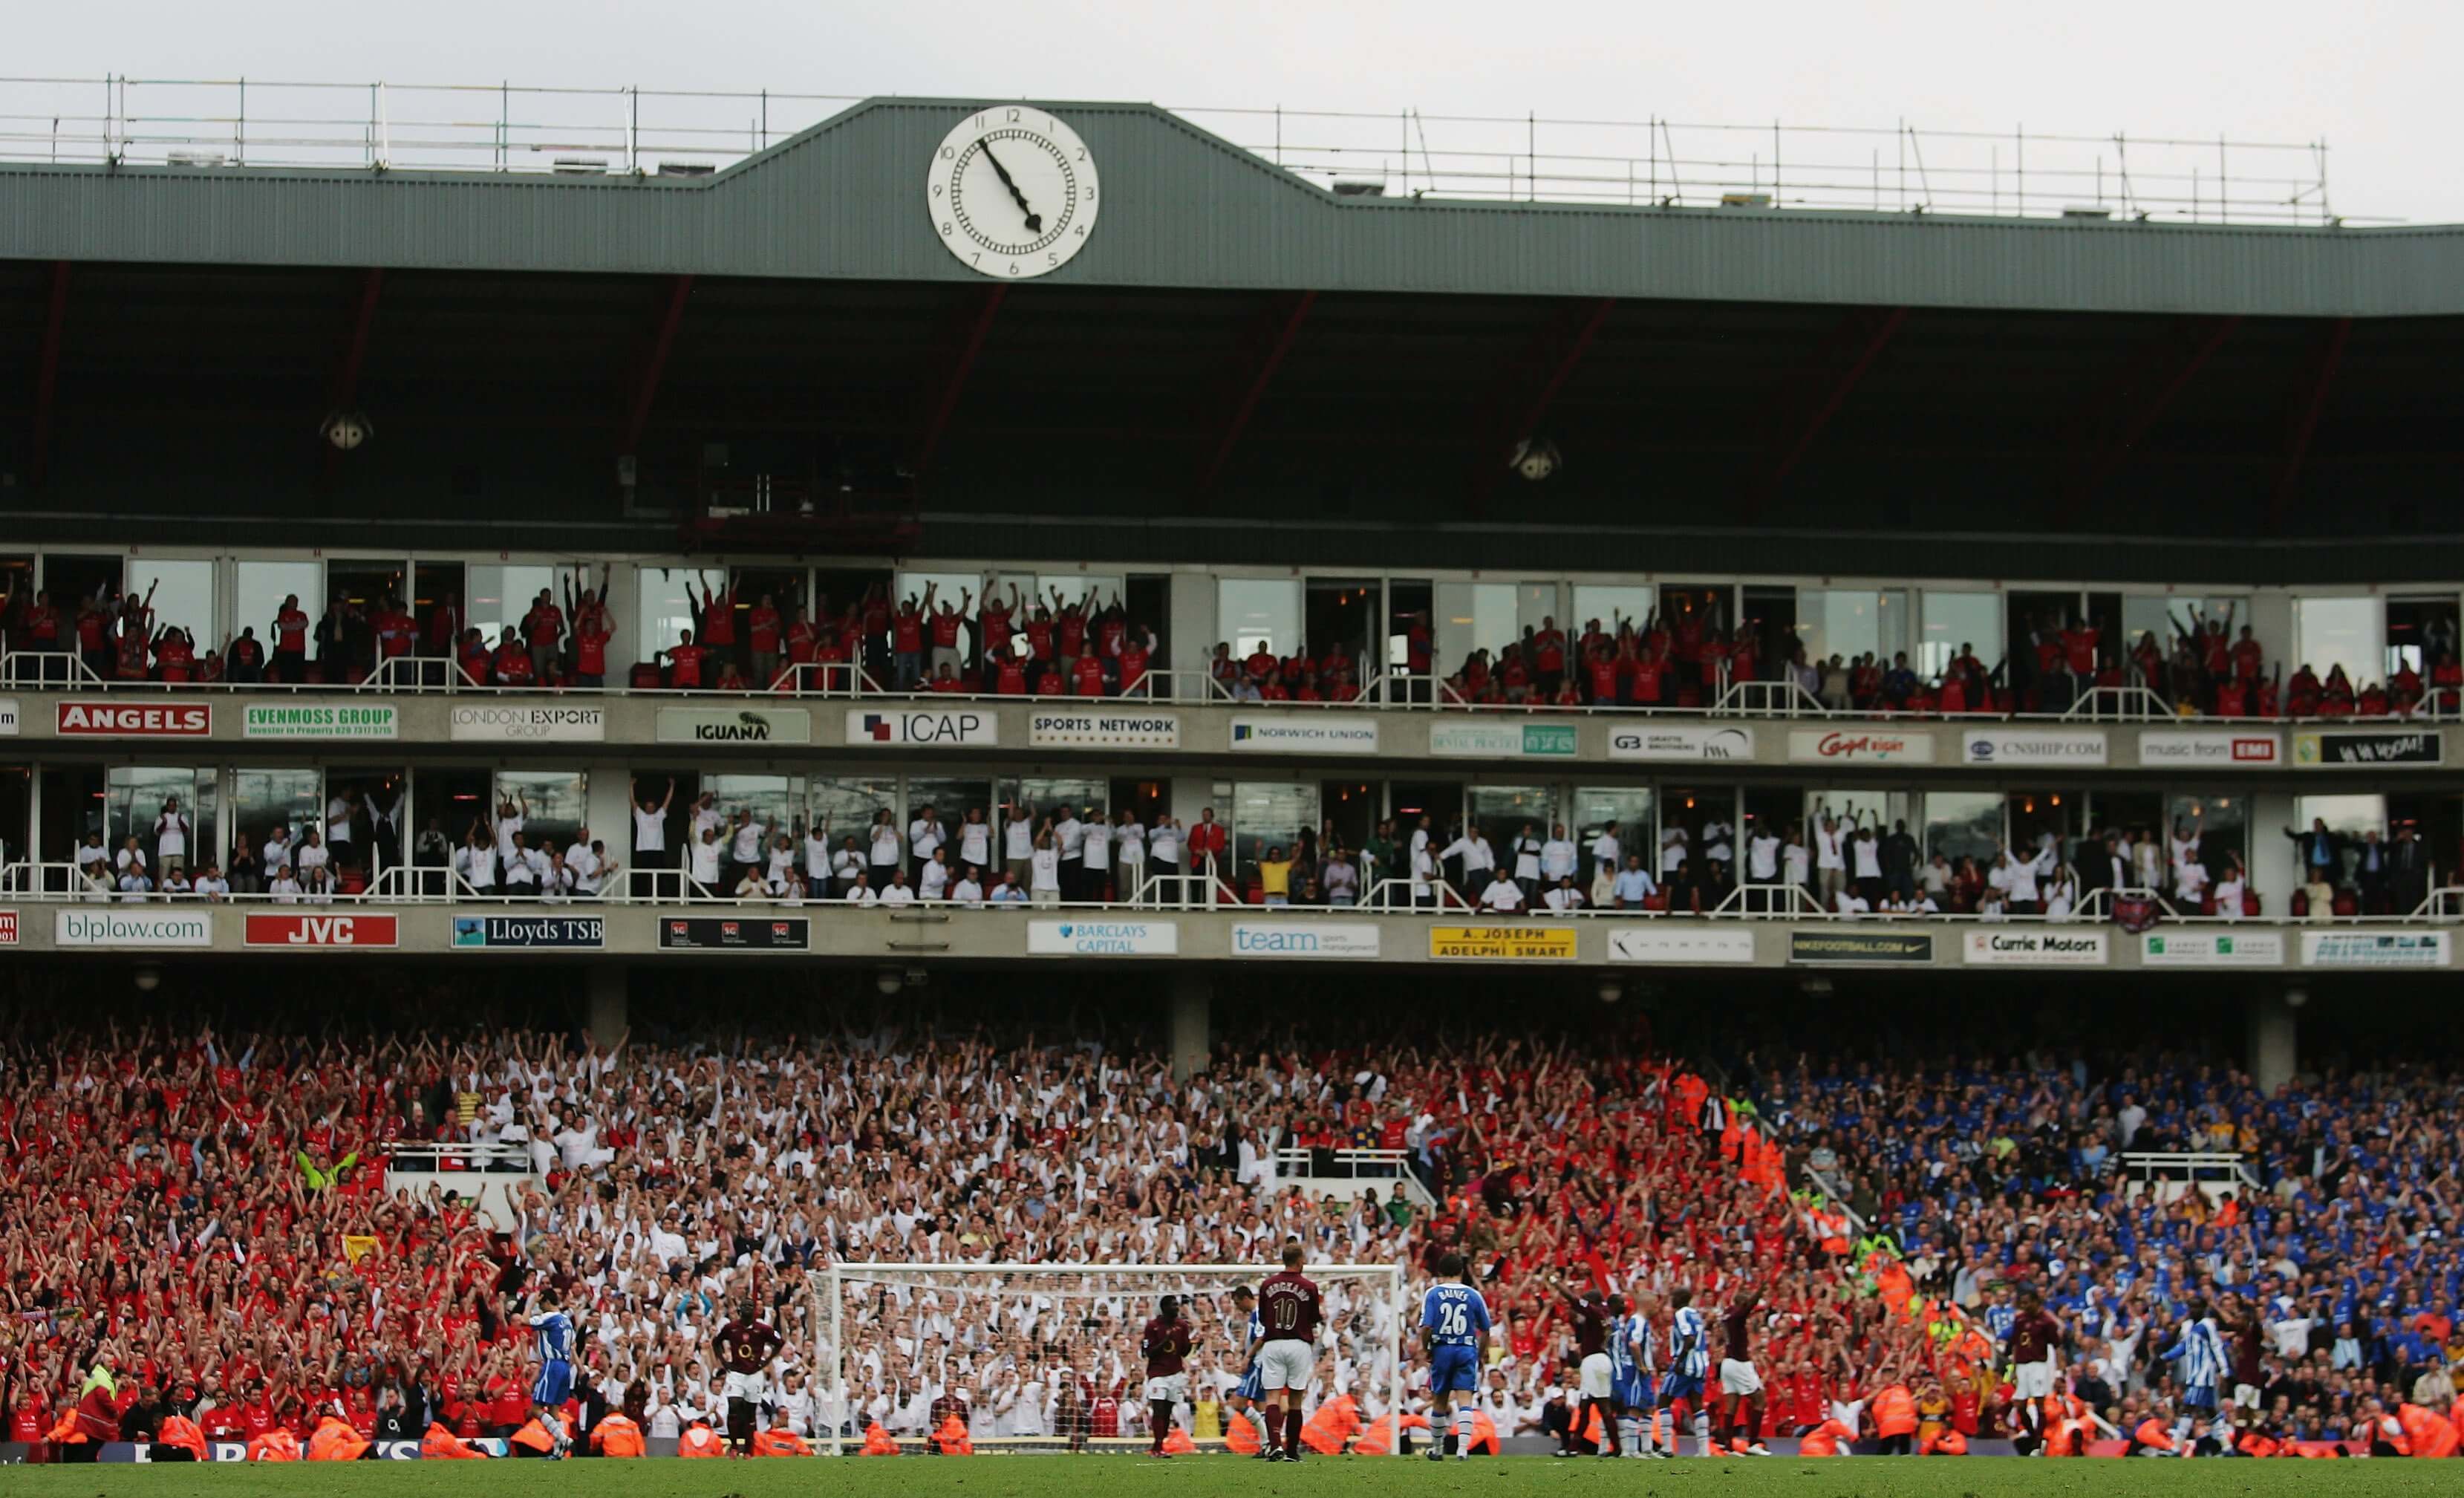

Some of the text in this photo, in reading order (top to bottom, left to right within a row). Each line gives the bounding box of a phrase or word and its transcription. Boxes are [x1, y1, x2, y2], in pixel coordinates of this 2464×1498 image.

[975, 116, 985, 128] 11
[1006, 109, 1020, 123] 12
[940, 146, 954, 160] 10
[1077, 148, 1086, 161] 2
[933, 185, 942, 198] 9
[1085, 187, 1094, 201] 3
[942, 222, 952, 235] 8
[1075, 224, 1084, 236] 4
[971, 253, 980, 265] 7
[1048, 253, 1057, 266] 5
[1010, 262, 1019, 275] 6
[62, 706, 206, 729] ANGELS
[249, 709, 392, 725] EVENMOSS GROUP
[453, 709, 601, 725] LONDON EXPORT
[506, 725, 550, 737] GROUP
[696, 724, 767, 740] IGUANA
[902, 714, 979, 741] ICAP
[1034, 718, 1174, 732] SPORTS NETWORK
[1259, 728, 1373, 739] NORWICH UNION
[2194, 742, 2227, 756] from
[67, 914, 203, 942] blplaw.com
[288, 918, 354, 943] JVC
[492, 919, 602, 945] Lloyds TSB
[1077, 925, 1147, 937] BARCLAYS
[1483, 929, 1545, 939] JOSEPH
[1077, 939, 1135, 952] CAPITAL
[1235, 927, 1319, 951] team
[1992, 935, 2096, 951] Currie Motors
[1441, 946, 1567, 957] ADELPHI SMART
[1273, 1297, 1298, 1330] 10
[1439, 1302, 1468, 1335] 26
